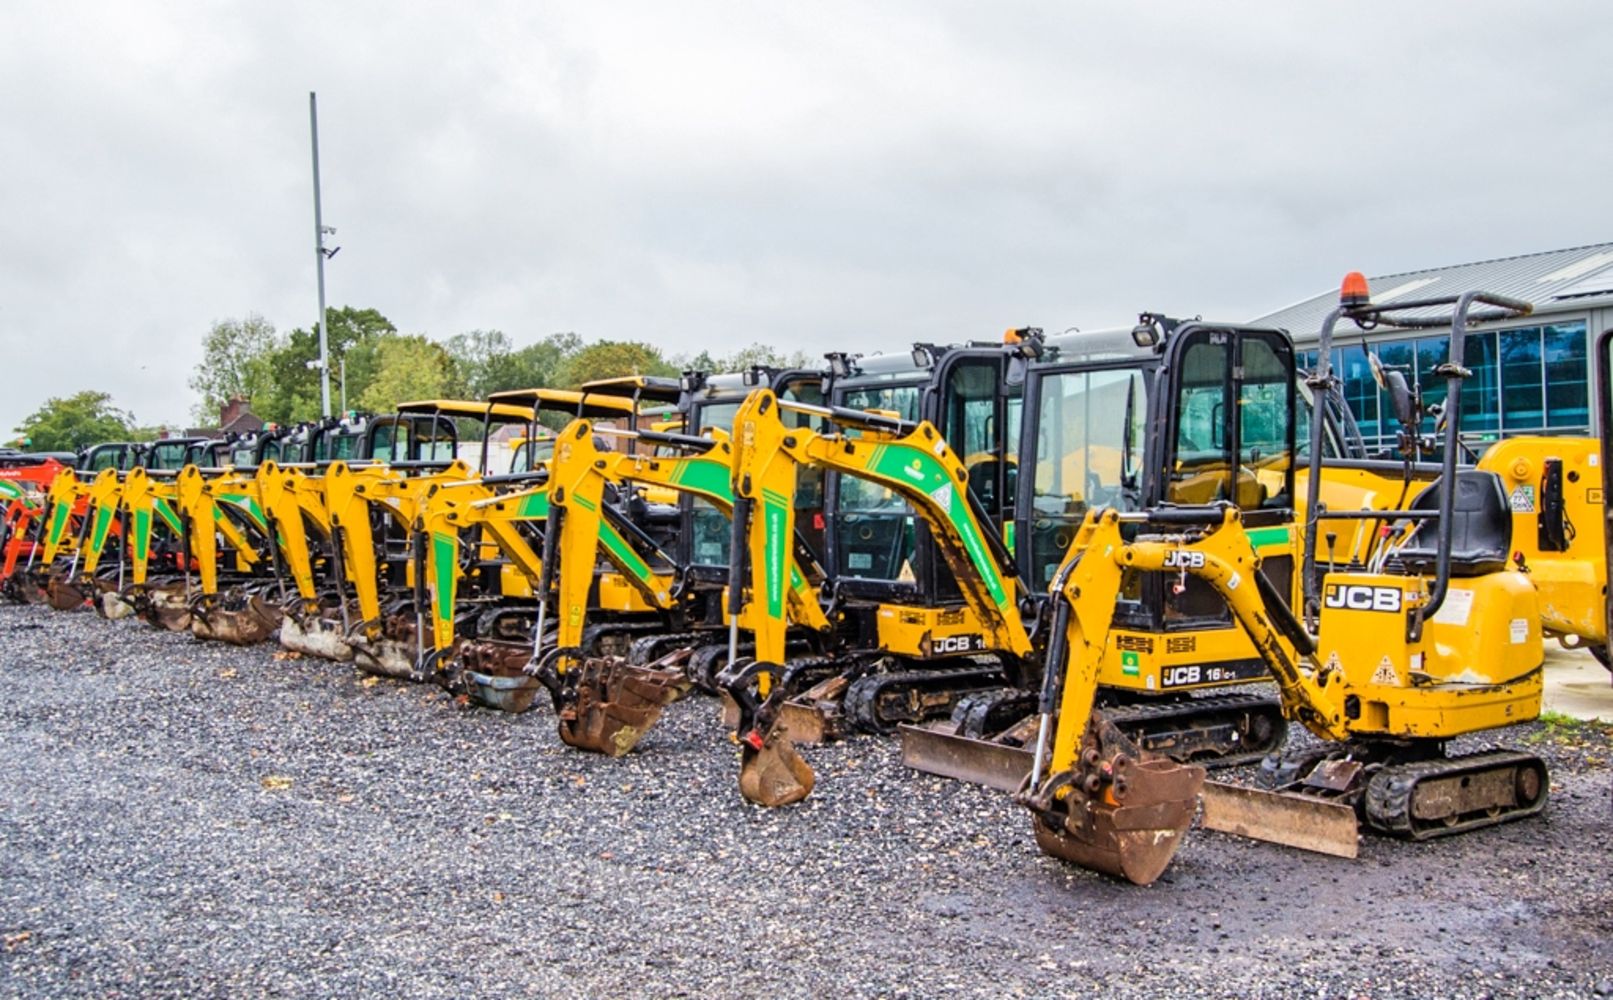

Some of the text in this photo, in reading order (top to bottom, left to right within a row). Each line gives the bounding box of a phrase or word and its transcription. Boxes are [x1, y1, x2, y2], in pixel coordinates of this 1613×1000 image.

[1164, 551, 1204, 568] JCB
[1326, 585, 1400, 611] JCB
[934, 636, 970, 653] JCB
[1163, 666, 1201, 686] JCB
